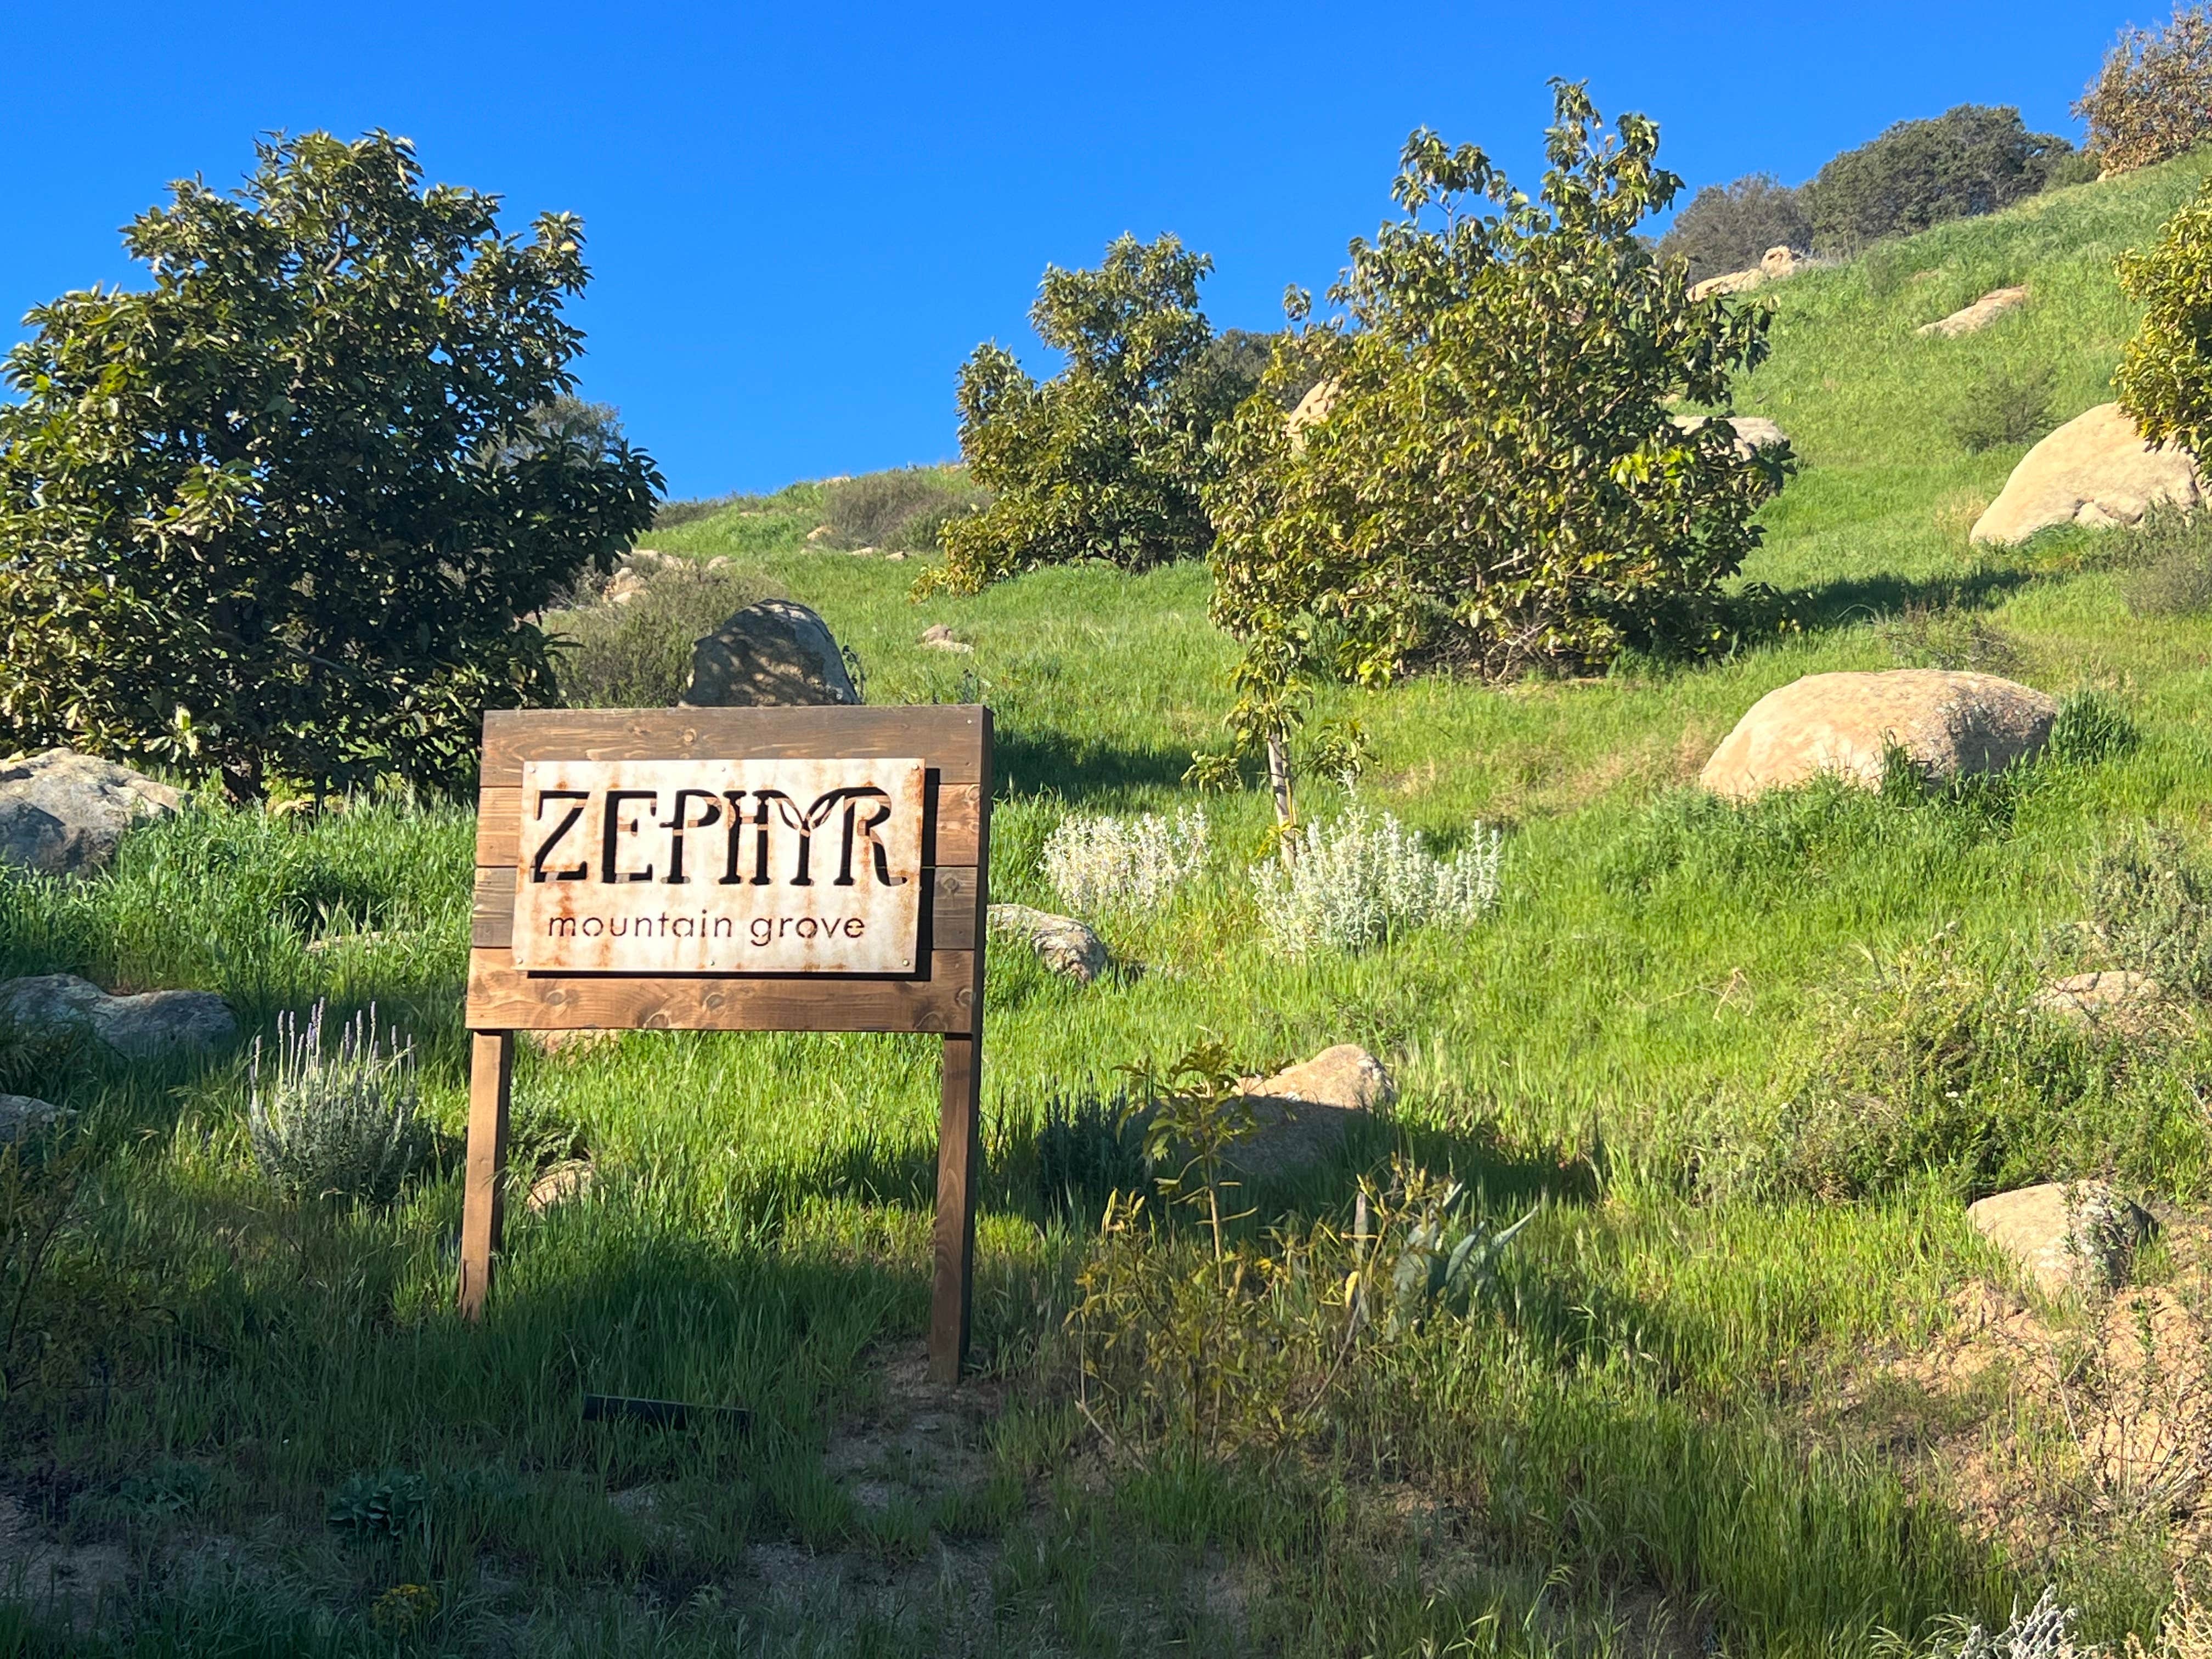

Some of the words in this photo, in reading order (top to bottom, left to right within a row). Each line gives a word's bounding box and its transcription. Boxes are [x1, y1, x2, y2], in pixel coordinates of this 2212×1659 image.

[529, 786, 908, 887] ZEPHYR
[548, 909, 733, 939] mountain
[750, 916, 866, 946] grove
